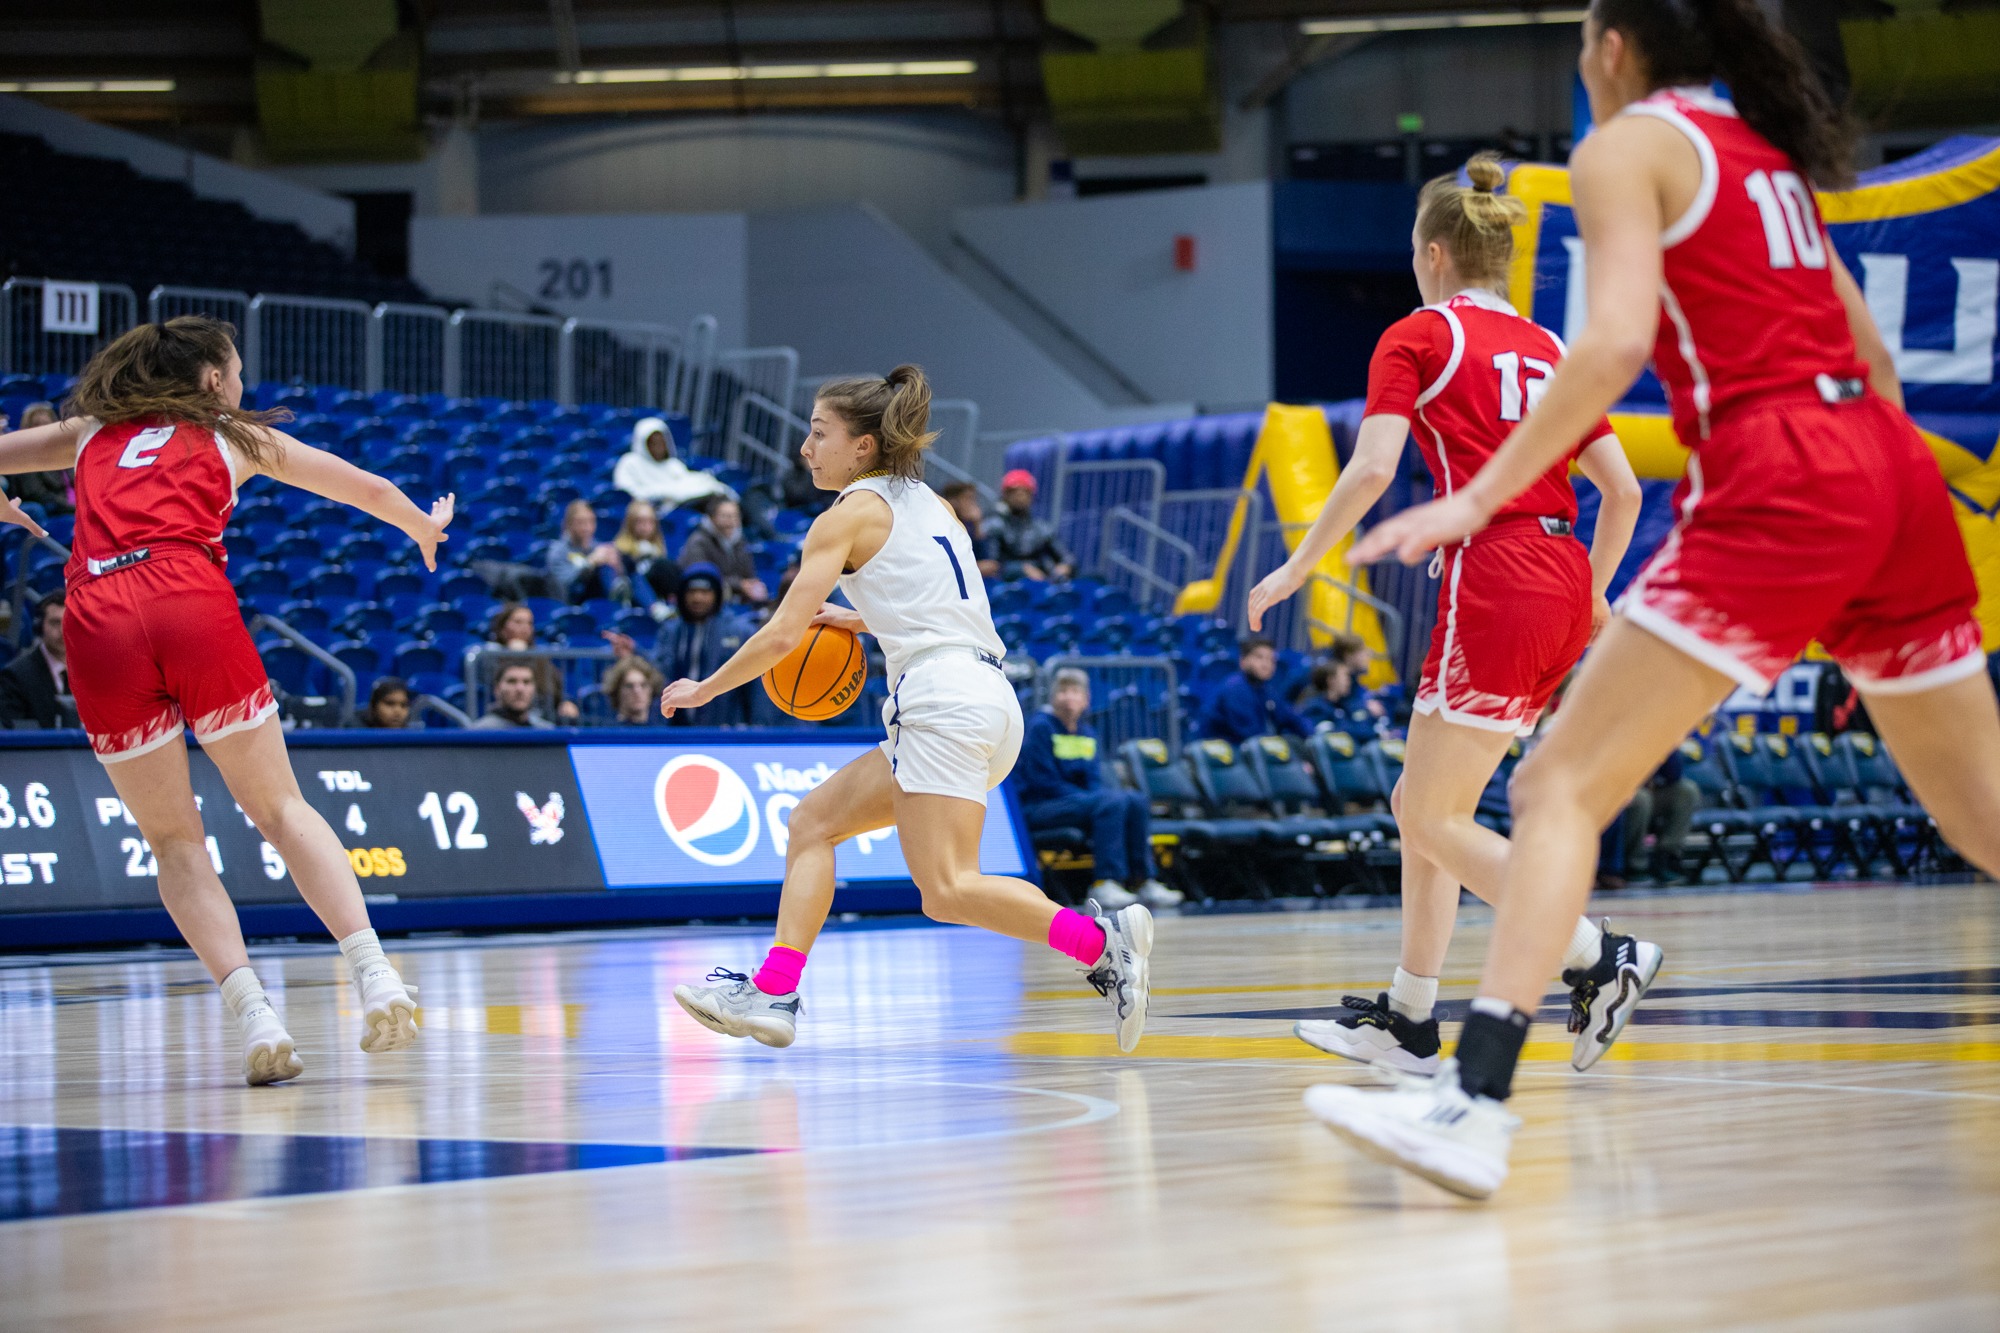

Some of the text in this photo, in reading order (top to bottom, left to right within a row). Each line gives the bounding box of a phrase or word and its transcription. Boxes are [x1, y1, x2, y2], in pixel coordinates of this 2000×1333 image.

[1744, 168, 1828, 269] 10
[539, 259, 613, 300] 201
[56, 291, 89, 323] 111
[117, 425, 177, 469] 2
[932, 535, 969, 600] 1
[318, 770, 372, 791] TOL
[347, 803, 367, 835] 4
[418, 791, 488, 849] 12
[0, 852, 58, 885] ST
[344, 847, 407, 877] OSS
